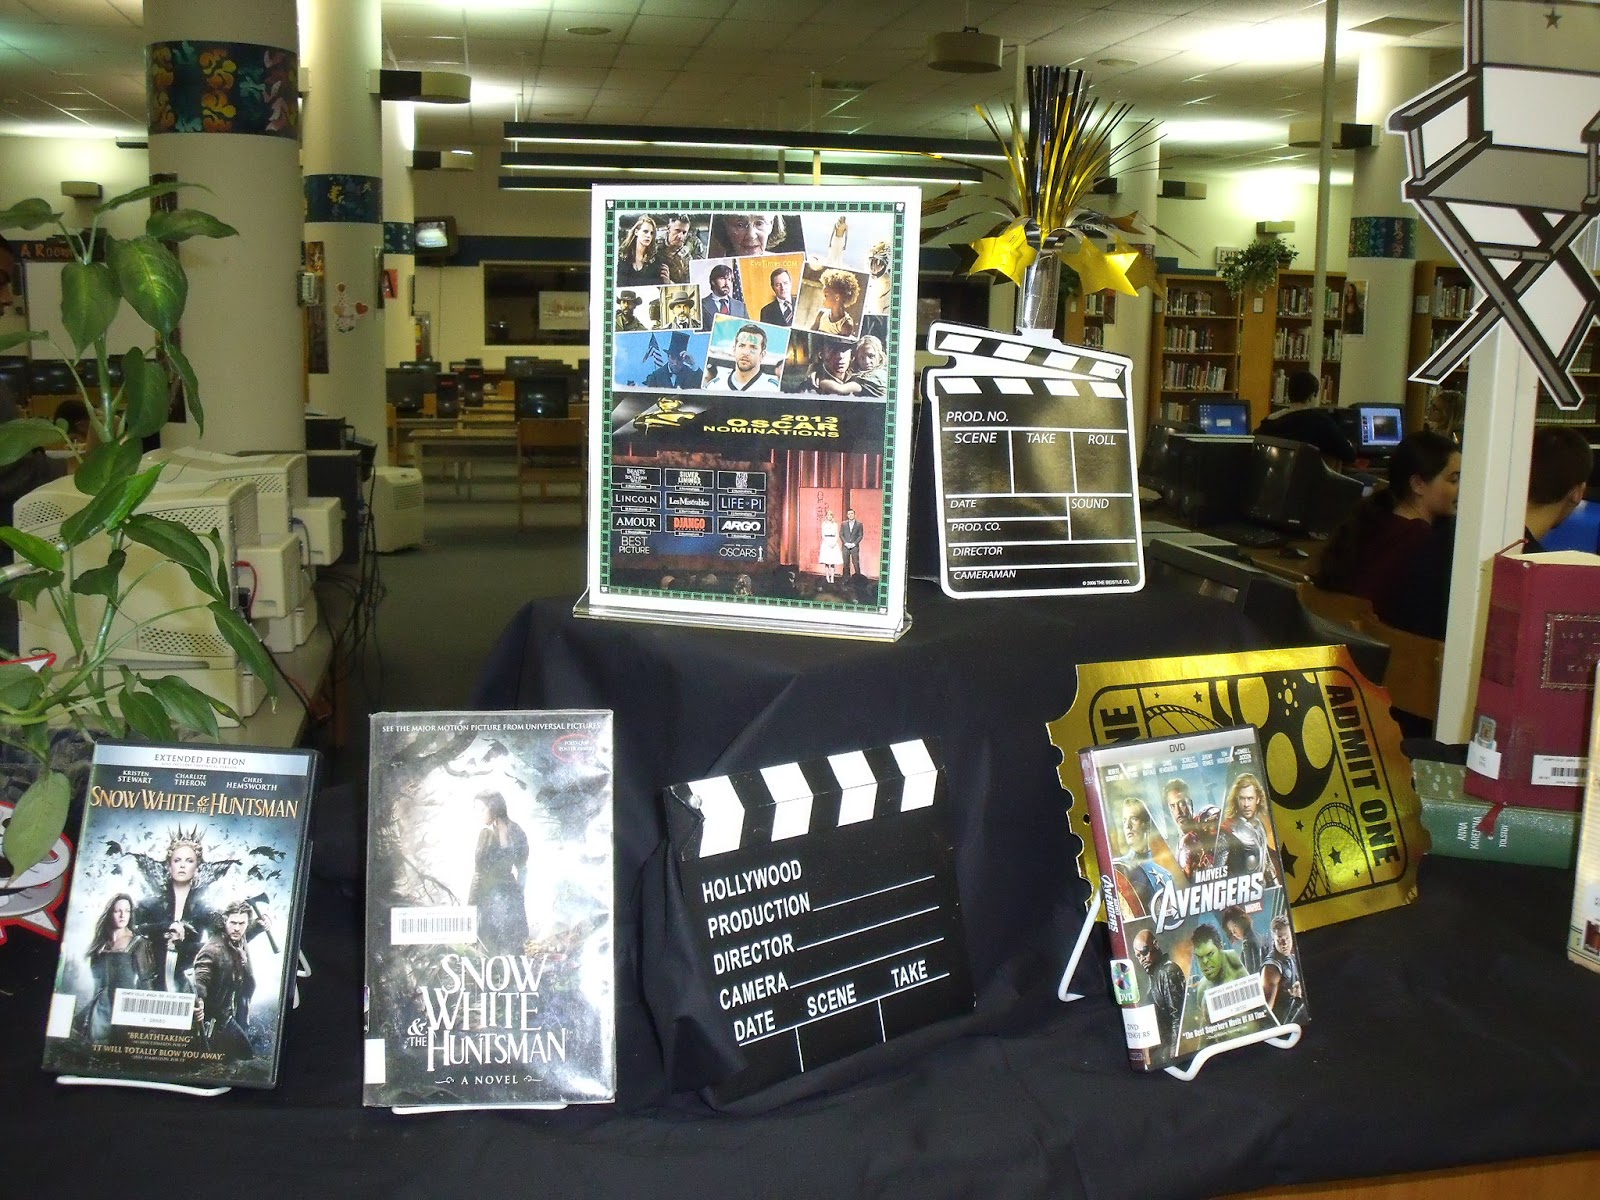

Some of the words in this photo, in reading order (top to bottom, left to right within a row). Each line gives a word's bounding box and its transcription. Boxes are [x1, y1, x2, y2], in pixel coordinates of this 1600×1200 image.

[781, 414, 838, 424] 2013
[946, 410, 985, 422] PROD.
[986, 410, 1009, 422] NO.
[727, 418, 838, 432] OSCAR
[703, 426, 840, 438] NOMINATIONS
[954, 432, 998, 444] SCENE
[1026, 433, 1056, 444] TAKE
[1087, 434, 1116, 446] ROLL
[615, 494, 656, 504] LINCOLN
[721, 498, 744, 510] LIFE
[750, 498, 762, 510] PI
[950, 500, 977, 508] DATE
[1071, 498, 1109, 509] SOUND
[616, 517, 656, 528] AMOUR
[673, 517, 706, 530] DJANGO
[721, 520, 762, 532] ARGO
[951, 522, 983, 532] PROD.
[984, 522, 1002, 532] CO.
[621, 536, 648, 546] BEST
[618, 546, 650, 554] PICTURE
[719, 547, 758, 558] OSCARS
[952, 546, 1004, 556] DIRECTOR
[953, 570, 1016, 580] CAMERAMAN
[411, 724, 436, 732] MAJOR
[437, 724, 469, 732] MOTION
[526, 722, 566, 730] UNIVERSAL
[566, 722, 601, 730] PICTURES
[1100, 705, 1141, 740] NE
[1169, 742, 1186, 752] DVD
[154, 754, 203, 764] EXTENDED
[206, 757, 246, 766] EDITION
[117, 776, 153, 784] STEWART
[175, 772, 207, 780] CHARLIZE
[242, 776, 263, 784] CHRIS
[1325, 685, 1381, 790] ADMIT
[1360, 798, 1400, 866] ONE
[174, 779, 207, 787] THERON
[226, 782, 278, 792] HEMSWORTH
[90, 786, 140, 808] SNOW
[141, 789, 196, 813] WHITE
[196, 796, 210, 807] &
[209, 792, 298, 819] HUNTSMAN
[1457, 822, 1468, 842] ANNA
[702, 859, 802, 903] HOLLYWOOD
[1150, 872, 1264, 934] AVENGERS
[708, 892, 811, 939] PRODUCTION
[713, 933, 795, 975] DIRECTOR
[440, 953, 548, 994] SNOW
[719, 972, 789, 1010] CAMERA
[733, 1010, 776, 1042] DATE
[807, 983, 857, 1017] SCENE
[891, 960, 928, 988] TAKE
[1119, 993, 1134, 1002] DVD
[420, 985, 542, 1031] WHITE
[407, 1018, 428, 1036] &
[128, 1032, 194, 1043] "BREATHTAKING"
[104, 1045, 122, 1054] WILL
[124, 1046, 158, 1056] TOTALLY
[160, 1049, 182, 1057] BLOW
[182, 1050, 200, 1059] YOU
[408, 1036, 428, 1047] THE
[426, 1027, 567, 1072] HUNTSMAN
[461, 1076, 468, 1085] A
[474, 1075, 519, 1085] NOVEL
